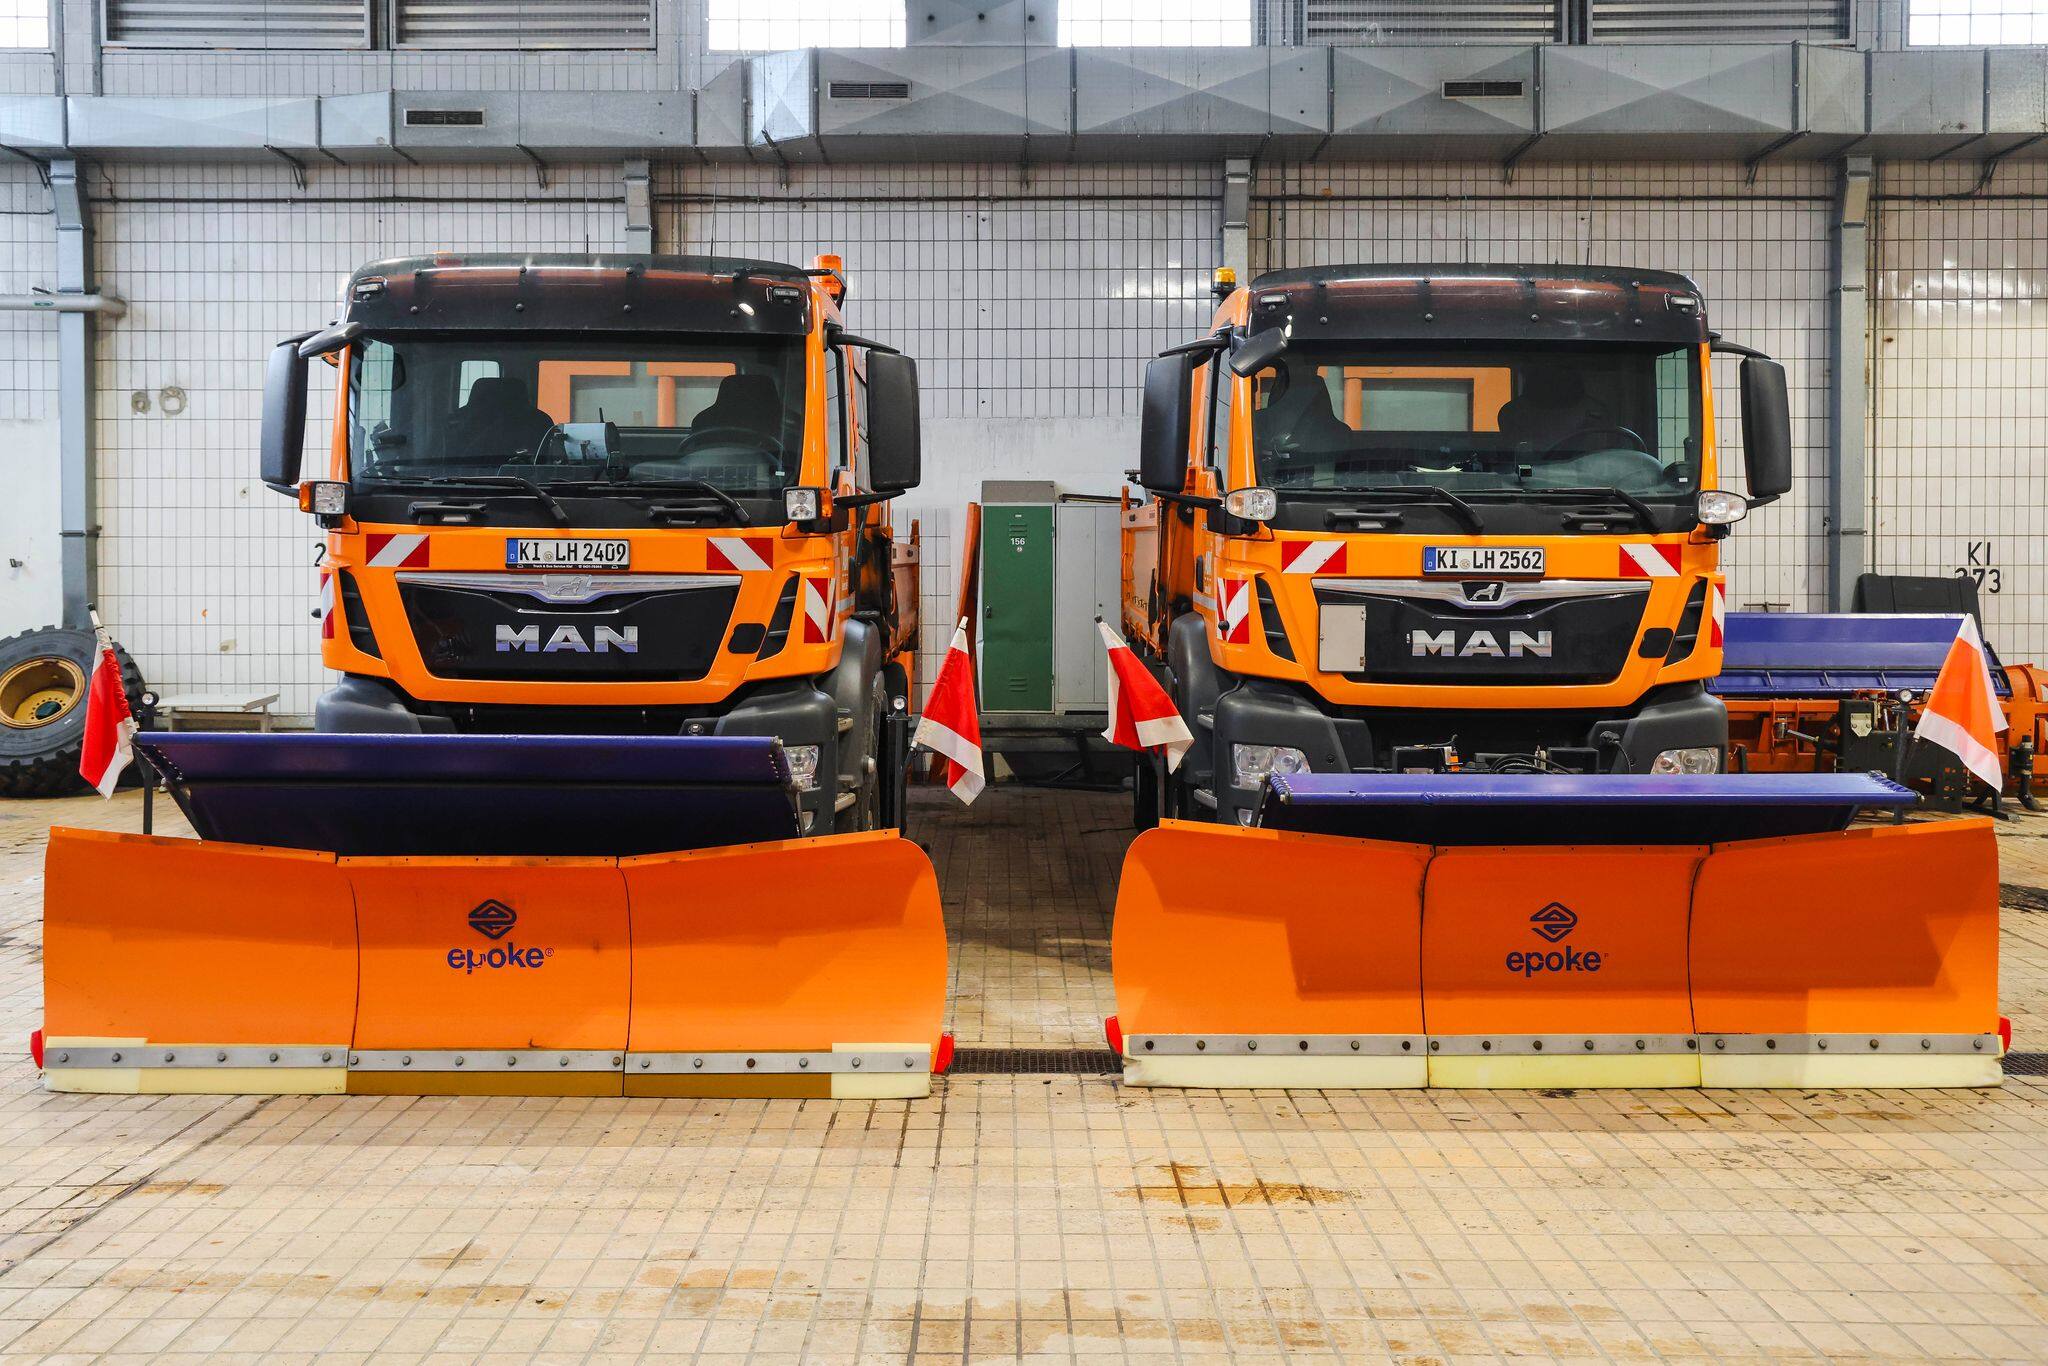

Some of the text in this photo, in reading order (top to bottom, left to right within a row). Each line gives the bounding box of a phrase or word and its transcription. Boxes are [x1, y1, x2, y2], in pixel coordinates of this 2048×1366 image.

[520, 542, 541, 562] KI
[555, 542, 578, 562] LH
[583, 542, 626, 562] 2409
[1010, 537, 1026, 546] 156
[1967, 541, 1991, 566] KI
[1437, 550, 1458, 569] KI
[1472, 550, 1495, 569] LH
[1499, 550, 1542, 570] 2562
[495, 624, 638, 653] MAN
[1412, 630, 1552, 657] MAN
[1505, 945, 1602, 978] epoke
